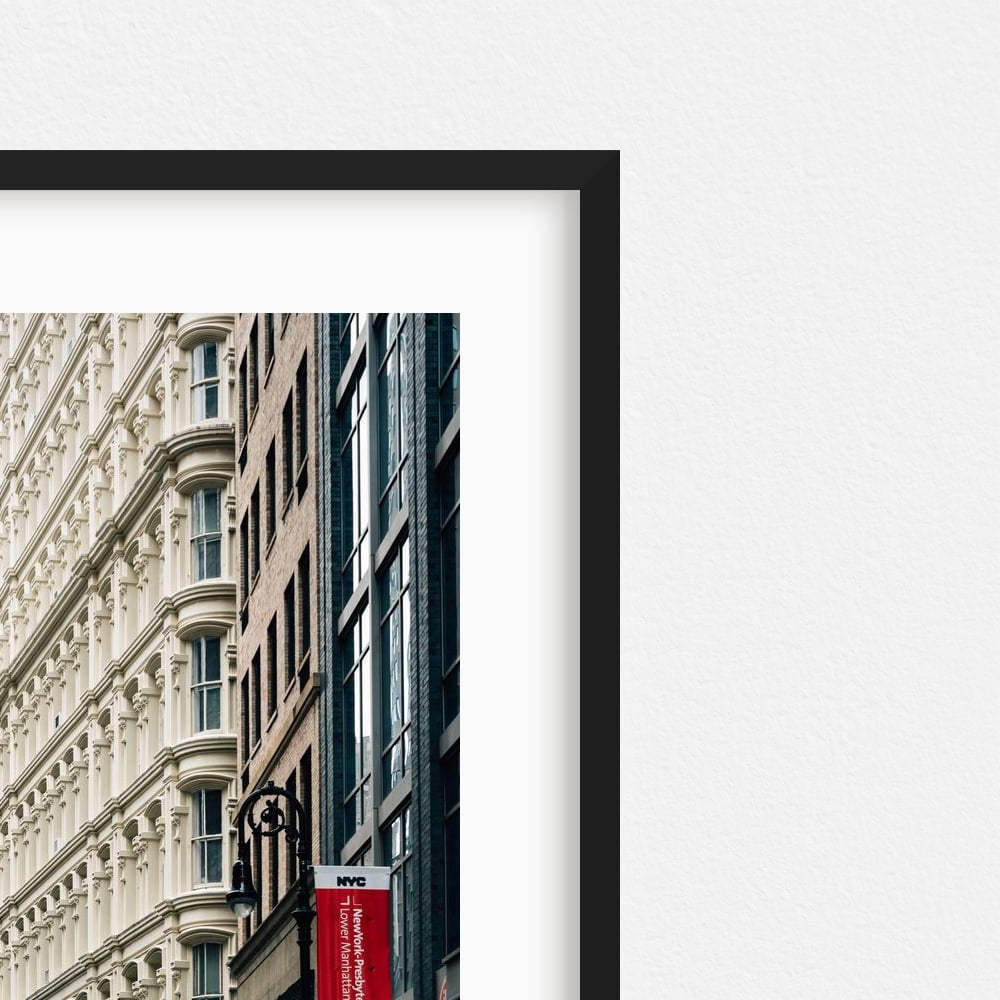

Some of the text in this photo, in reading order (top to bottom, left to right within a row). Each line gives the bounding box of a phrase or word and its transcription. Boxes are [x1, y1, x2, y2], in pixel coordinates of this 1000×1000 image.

[336, 876, 367, 887] NYC
[340, 908, 350, 940] Lower
[341, 942, 353, 1000] Manhattan
